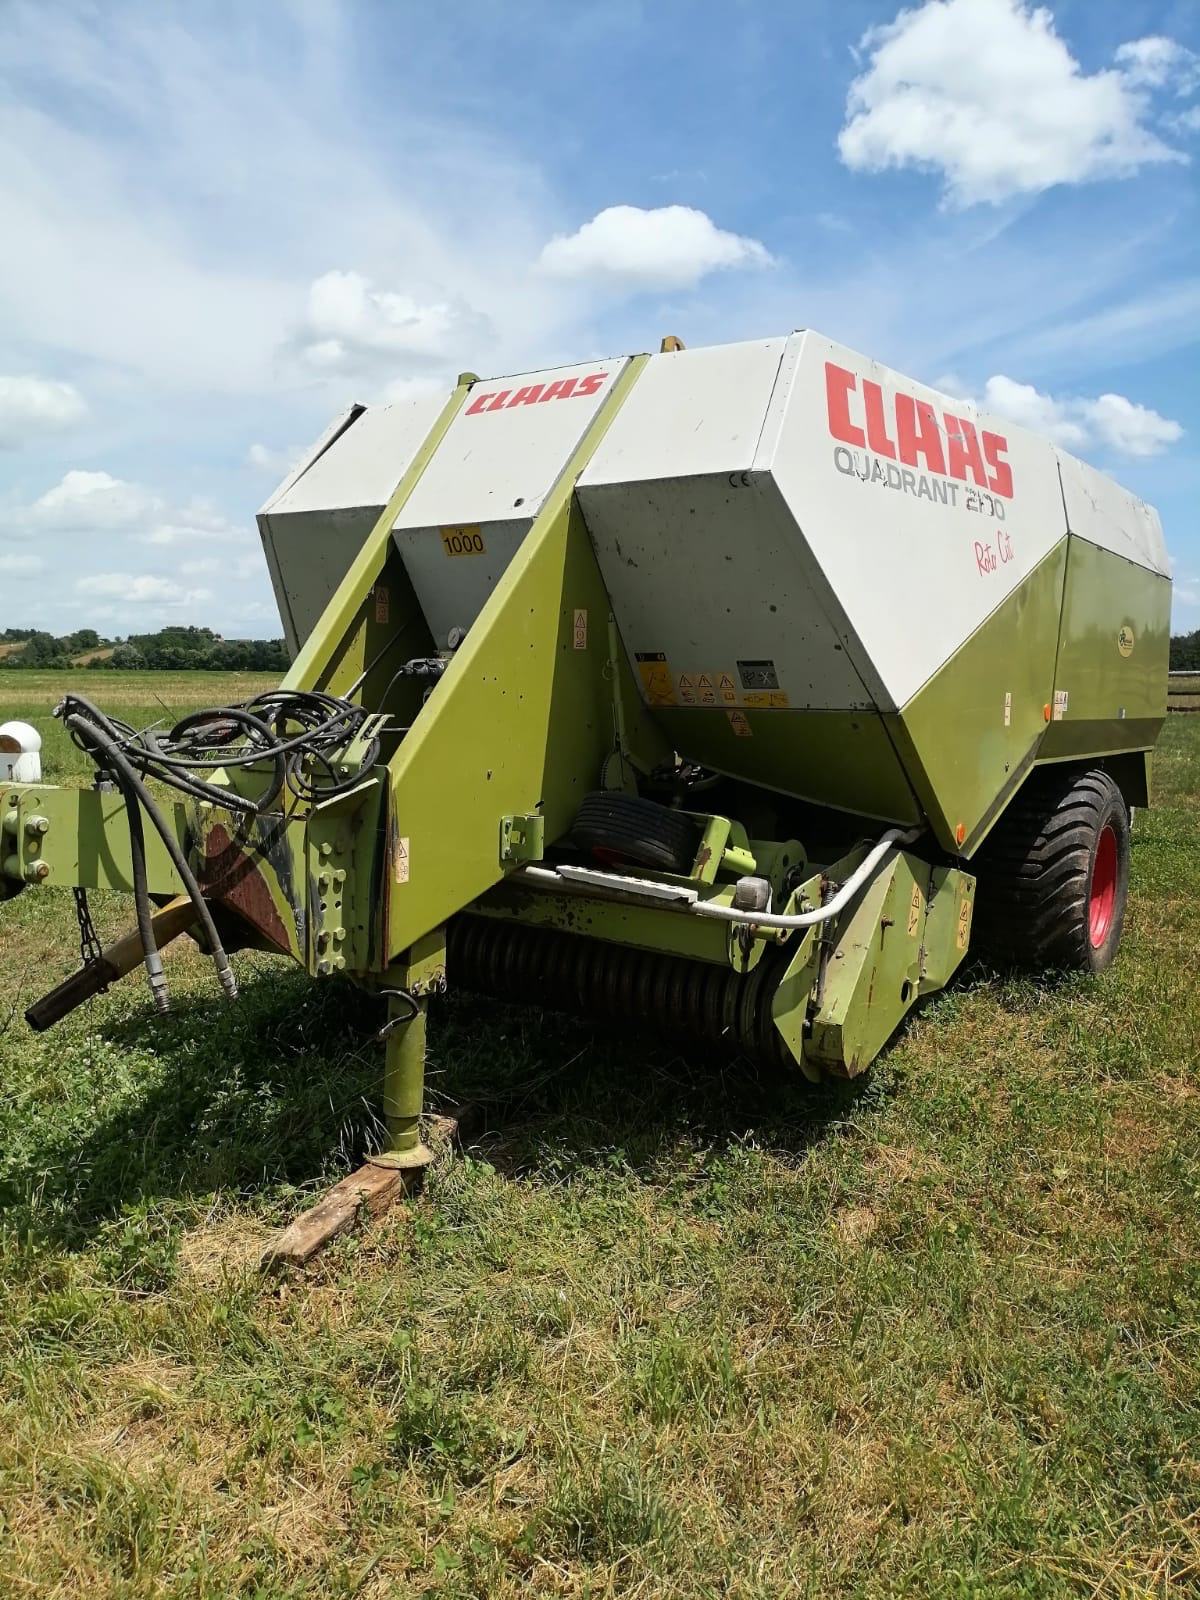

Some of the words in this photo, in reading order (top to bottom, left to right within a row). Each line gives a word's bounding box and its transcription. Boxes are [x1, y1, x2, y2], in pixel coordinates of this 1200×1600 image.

[465, 373, 609, 416] CLAAS
[825, 361, 1014, 499] CLAAS
[833, 446, 960, 507] QUADRANT
[443, 534, 484, 554] 1000
[974, 541, 997, 577] Roto
